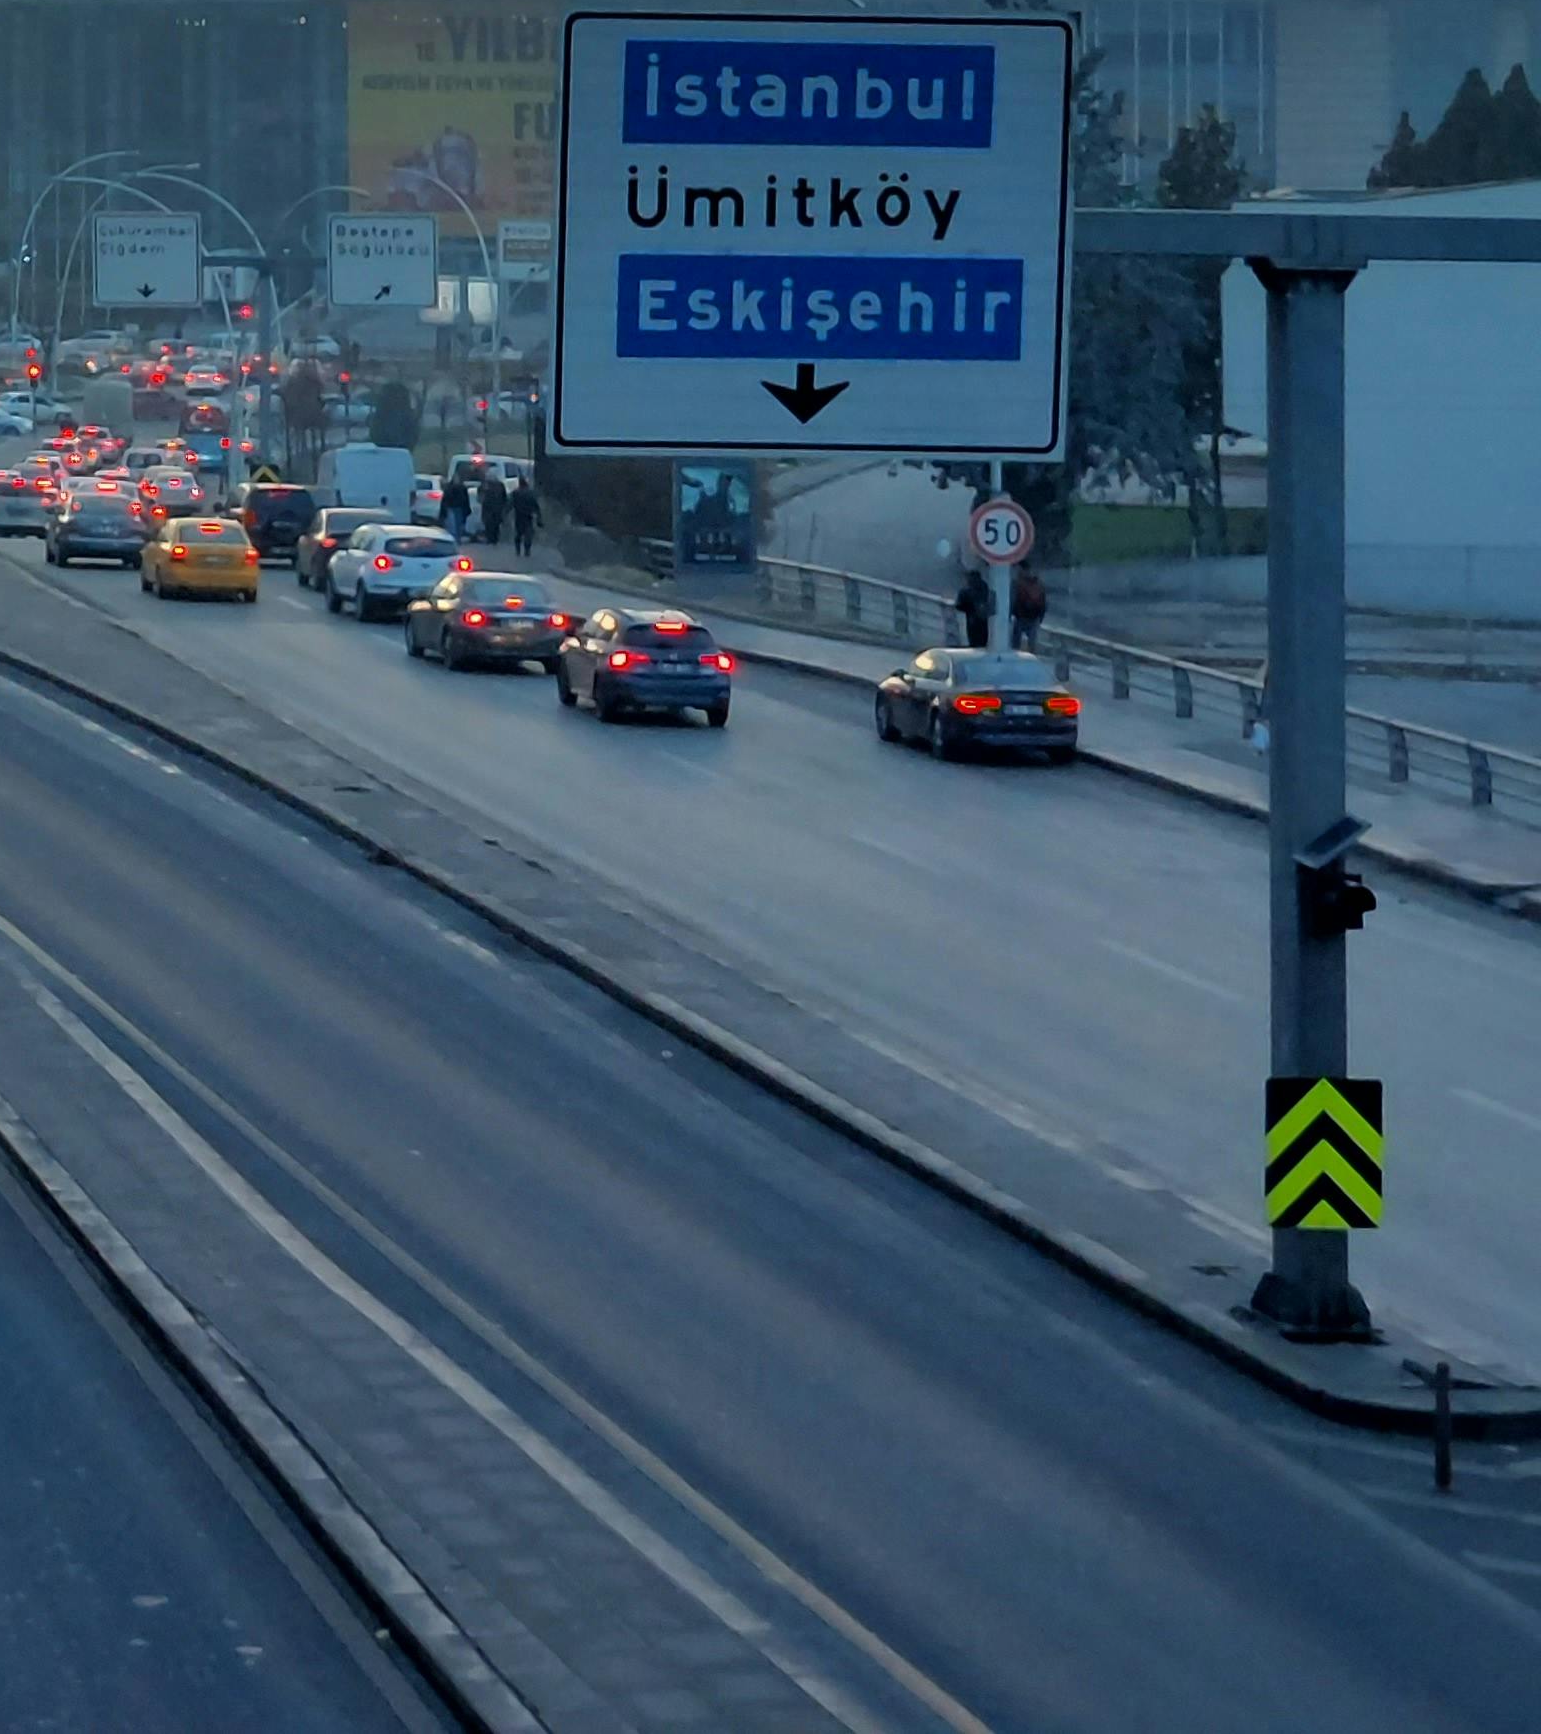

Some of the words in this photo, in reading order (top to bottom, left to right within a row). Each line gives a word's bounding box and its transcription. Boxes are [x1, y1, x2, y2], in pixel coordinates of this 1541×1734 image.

[645, 53, 975, 121] İstanbul
[627, 165, 960, 240] Ümitköy
[638, 278, 1011, 340] Eskişehir
[984, 518, 1021, 546] 50
